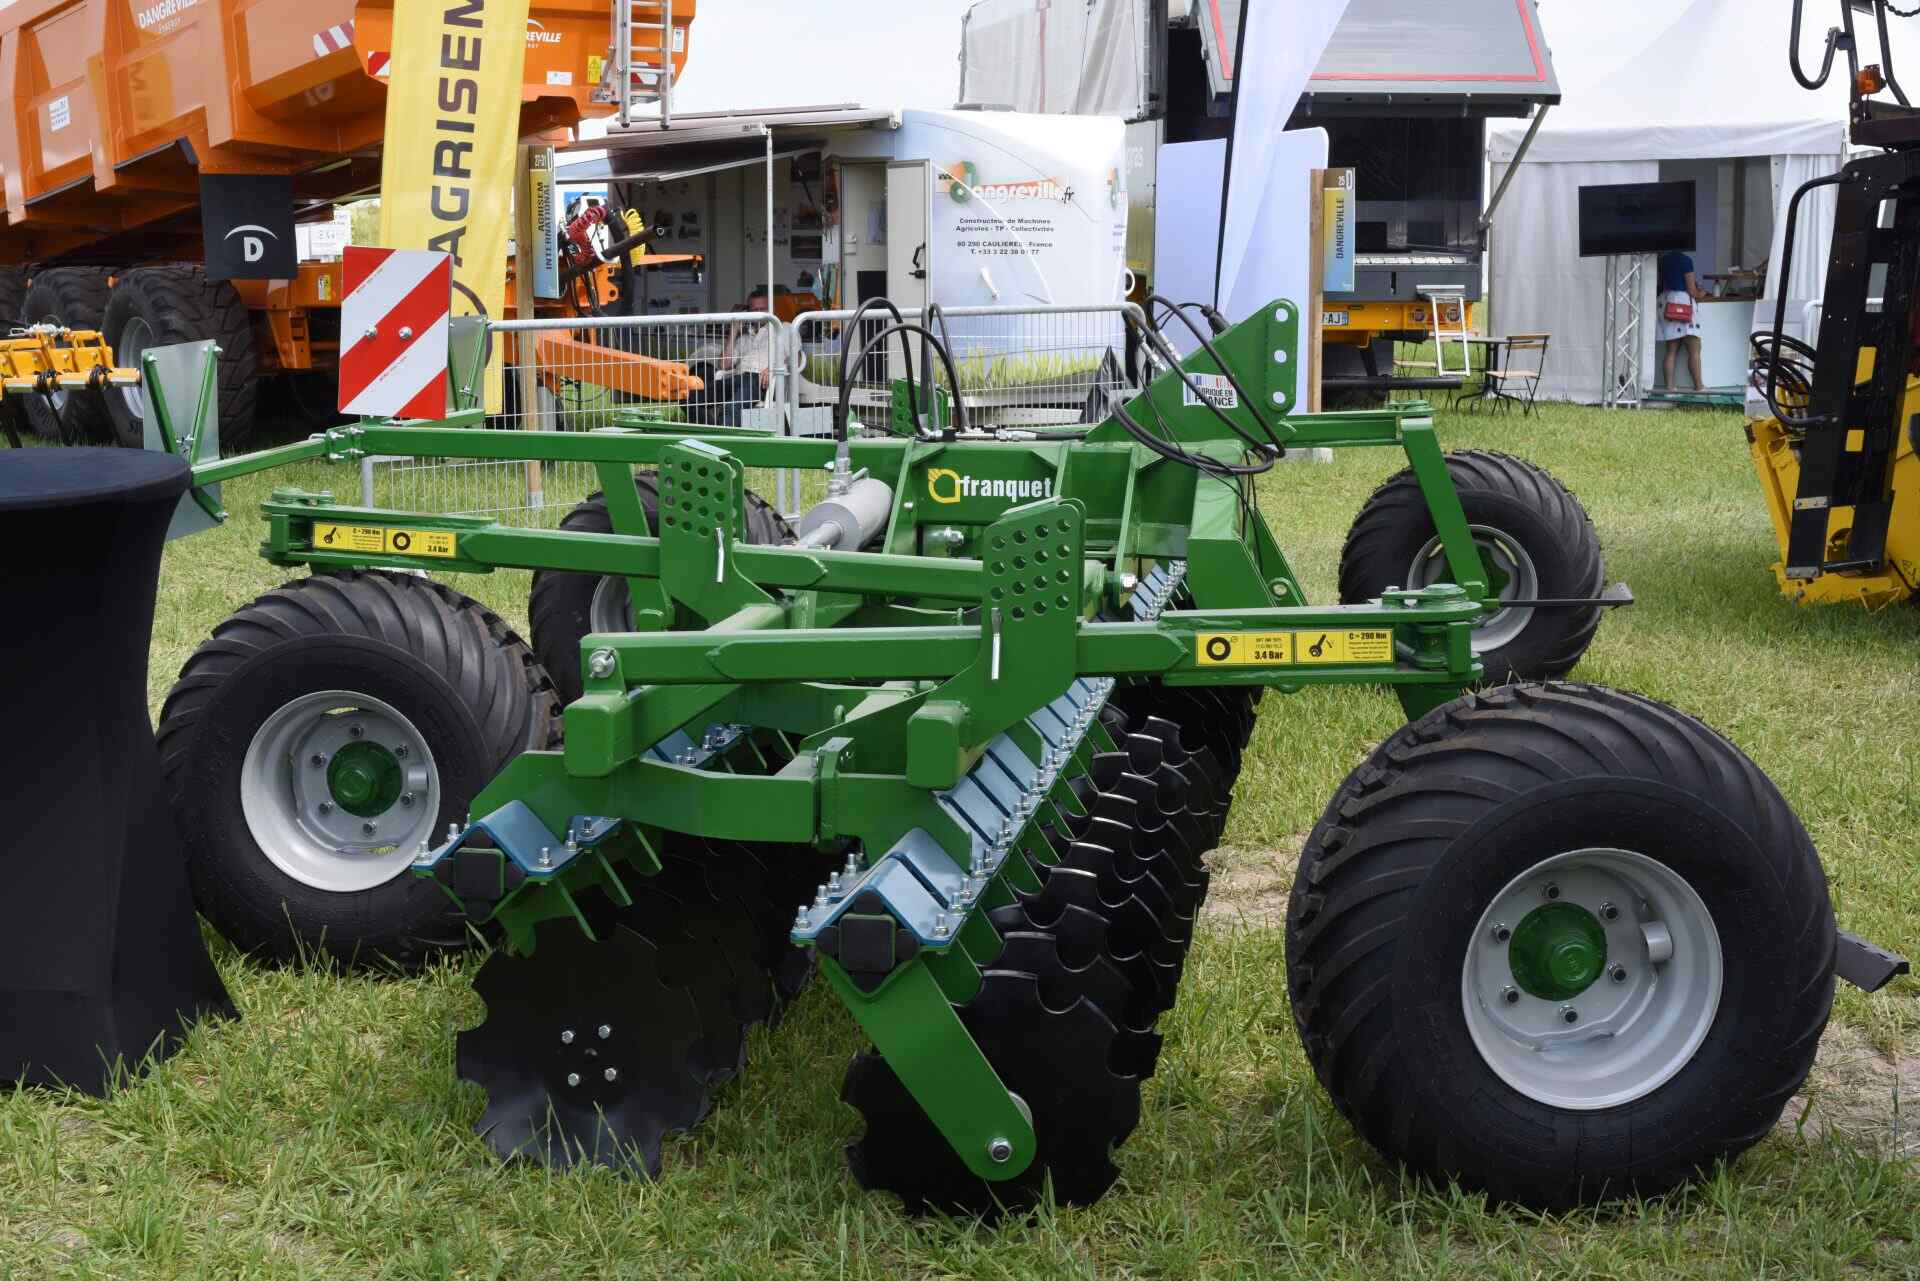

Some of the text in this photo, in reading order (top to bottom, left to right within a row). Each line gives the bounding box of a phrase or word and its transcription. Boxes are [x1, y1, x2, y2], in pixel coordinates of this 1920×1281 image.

[1338, 176, 1345, 186] 25
[544, 184, 553, 270] INTERNATIONAL
[1336, 197, 1344, 260] DANGREVILLE
[243, 236, 264, 262] D
[963, 475, 1052, 503] franquet
[437, 545, 449, 553] Bar
[1349, 632, 1354, 640] C
[1360, 632, 1375, 640] 290
[1268, 650, 1284, 660] Bar
